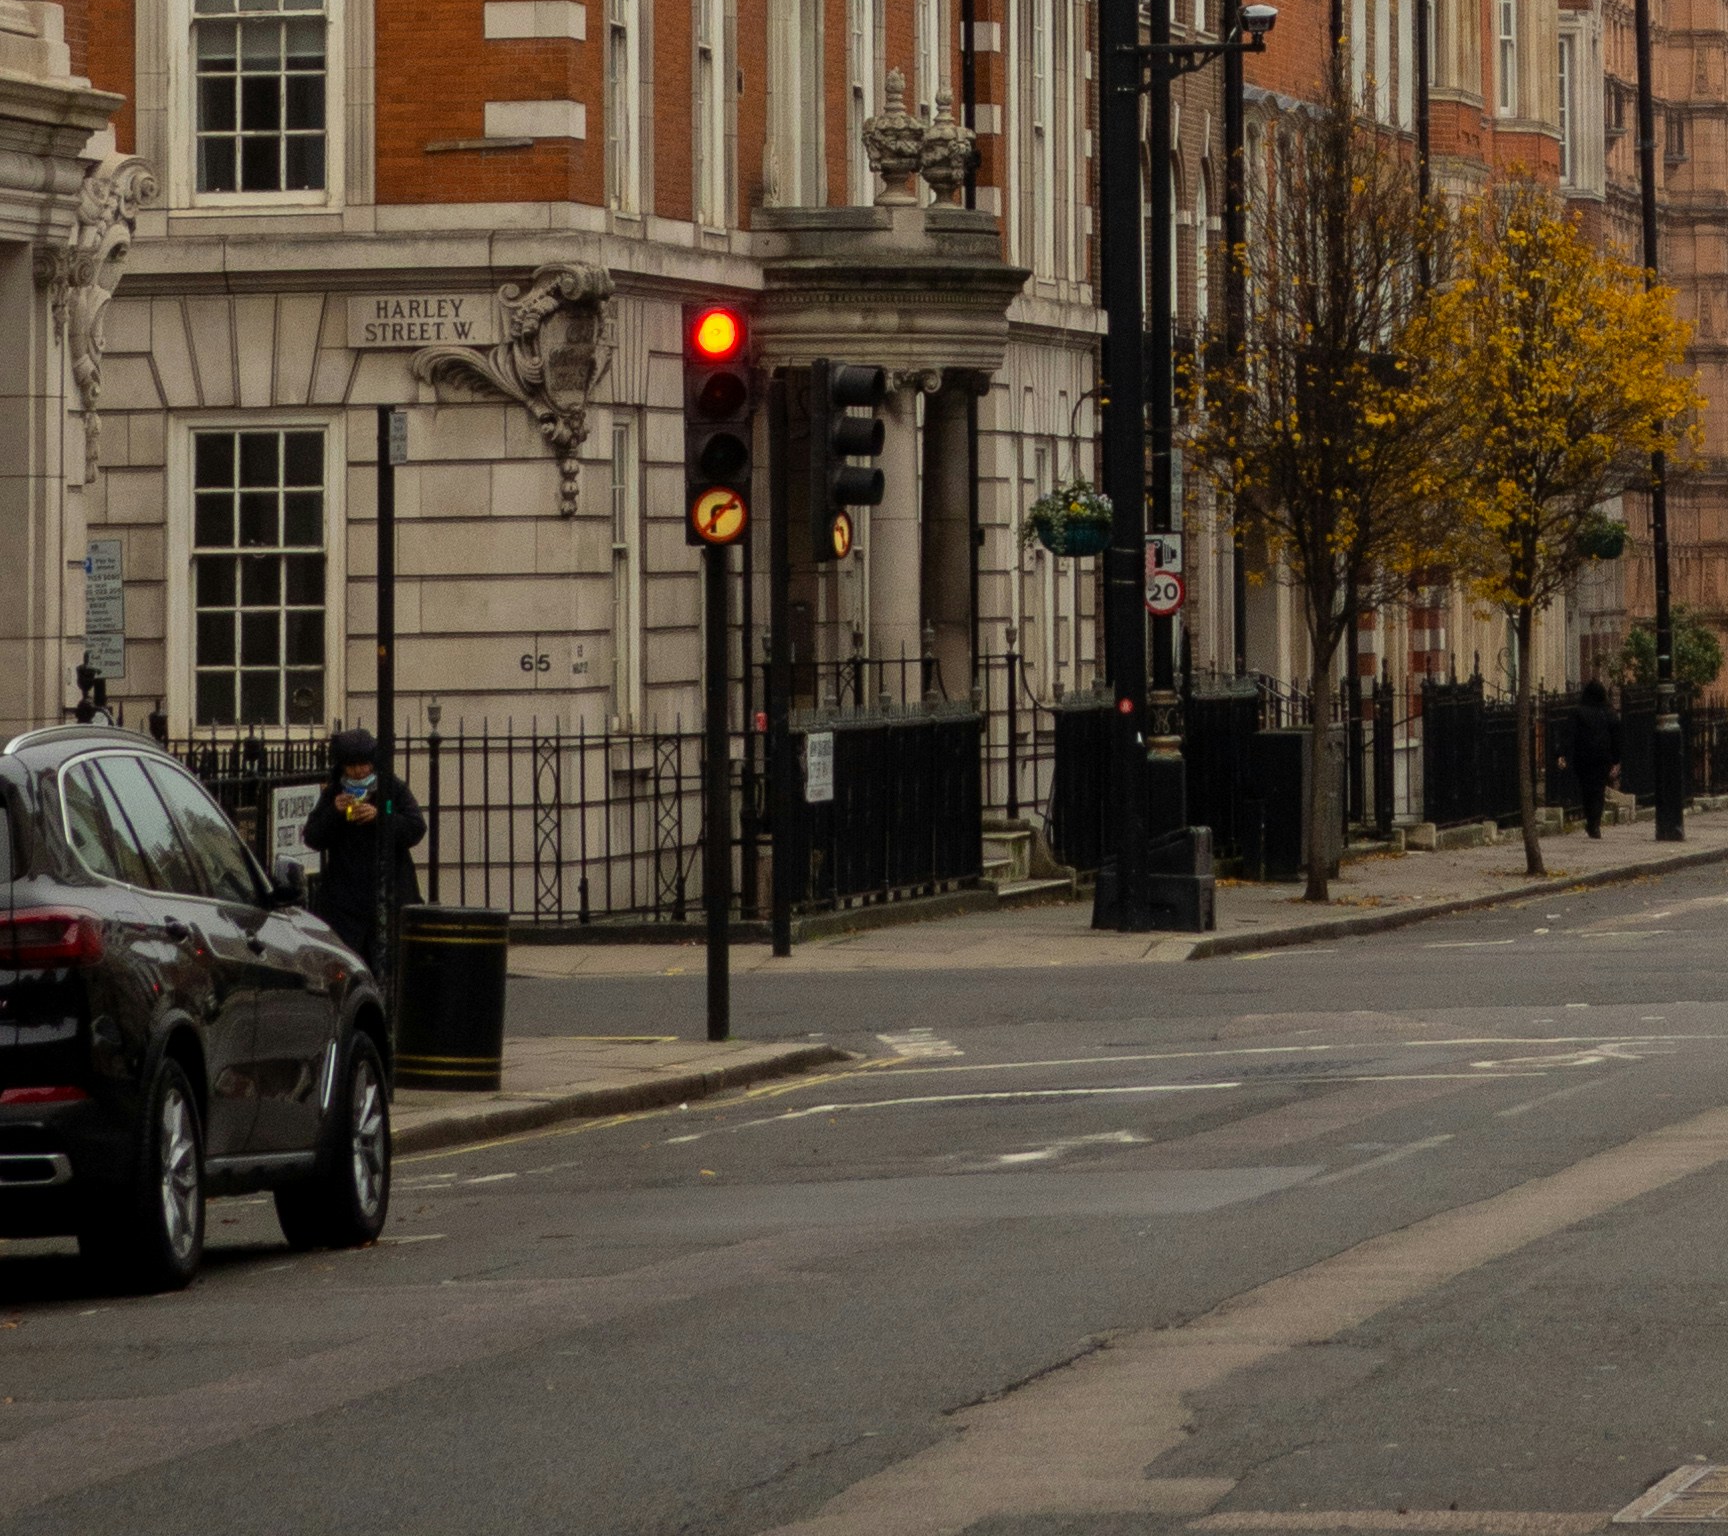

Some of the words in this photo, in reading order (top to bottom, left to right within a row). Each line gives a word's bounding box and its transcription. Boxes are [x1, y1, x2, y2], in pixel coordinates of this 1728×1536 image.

[375, 298, 464, 319] HARLEY
[1148, 582, 1178, 601] 20
[520, 654, 551, 672] 65
